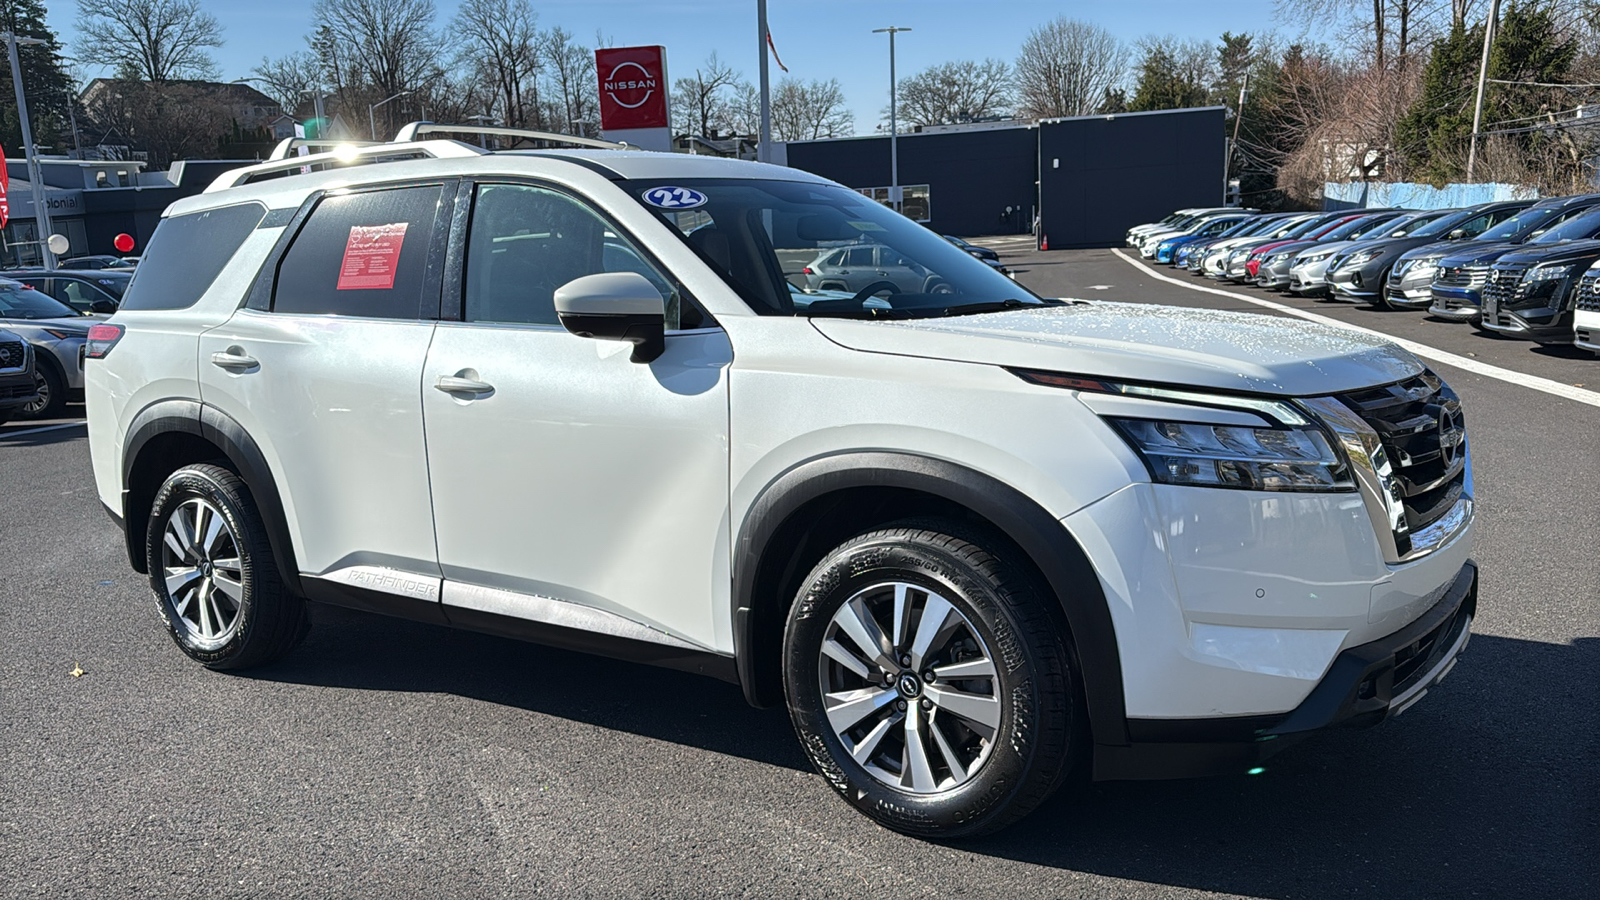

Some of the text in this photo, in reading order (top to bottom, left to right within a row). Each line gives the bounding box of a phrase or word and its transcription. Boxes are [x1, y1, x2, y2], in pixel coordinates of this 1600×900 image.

[604, 79, 656, 91] NISSAN
[653, 187, 699, 206] 22
[900, 555, 940, 574] 255/60
[348, 570, 437, 597] PATHFINDER
